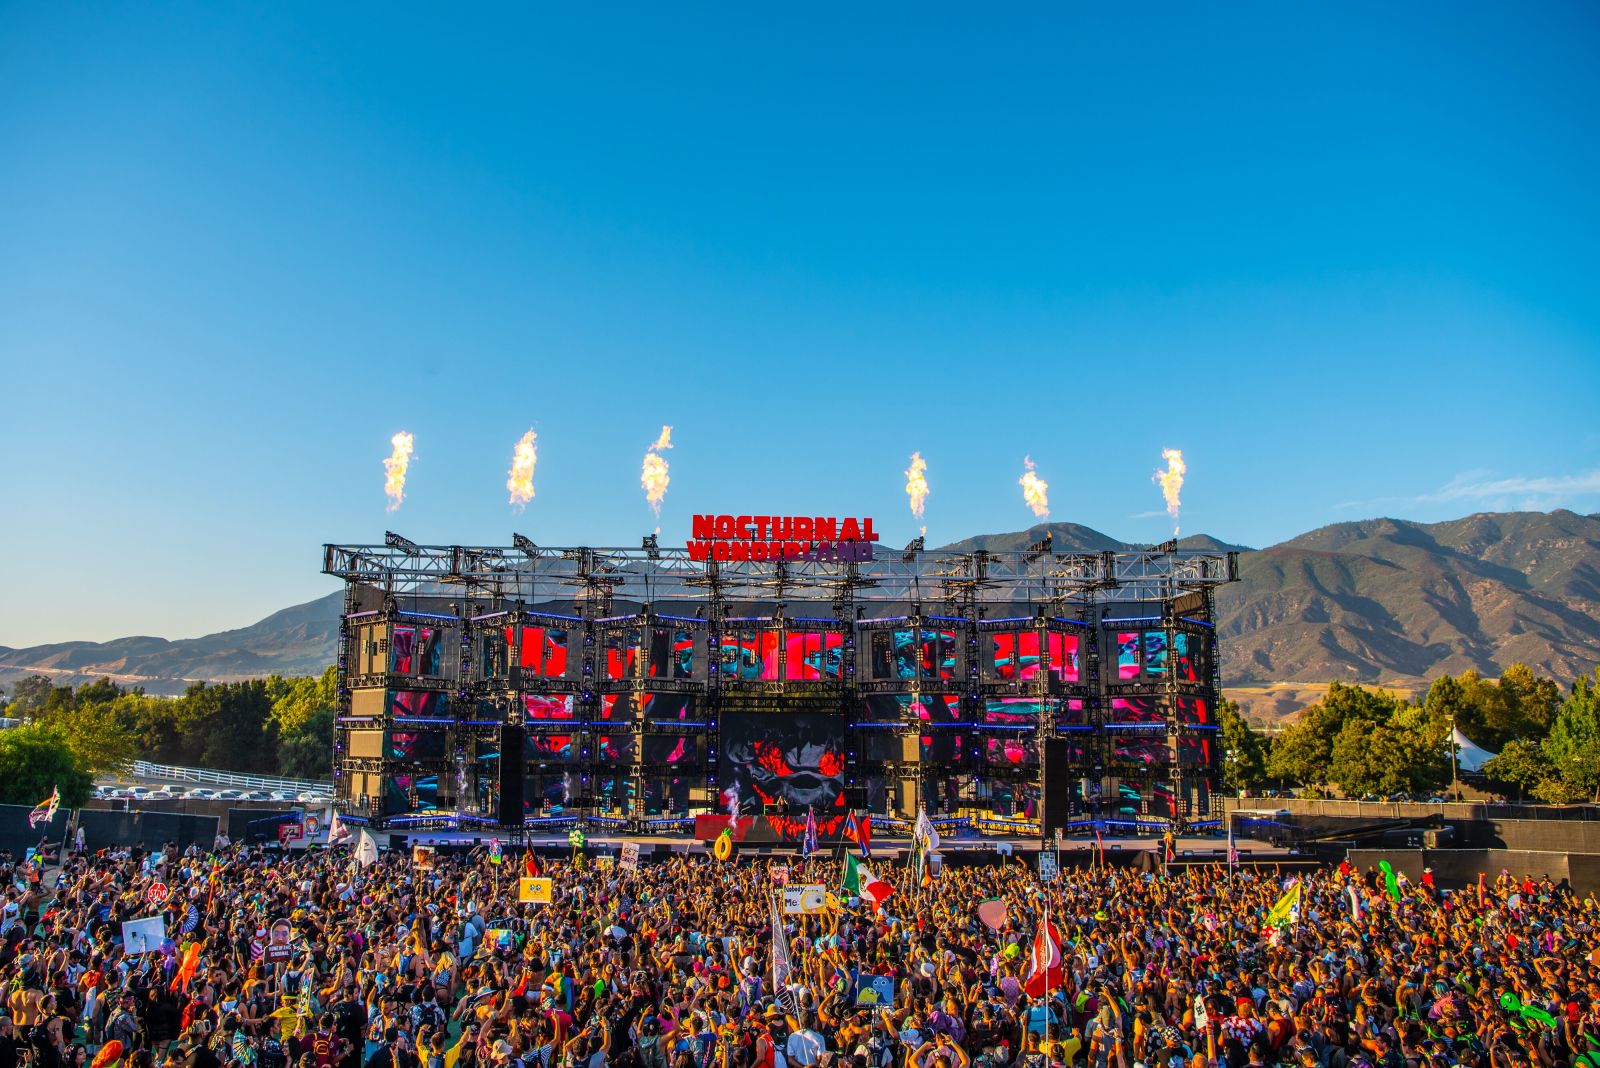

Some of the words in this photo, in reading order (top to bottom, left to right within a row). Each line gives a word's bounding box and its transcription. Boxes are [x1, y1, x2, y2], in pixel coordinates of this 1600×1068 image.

[692, 514, 879, 541] NOCTURNAL
[686, 541, 873, 562] WONDERLAND
[150, 889, 167, 898] STOP
